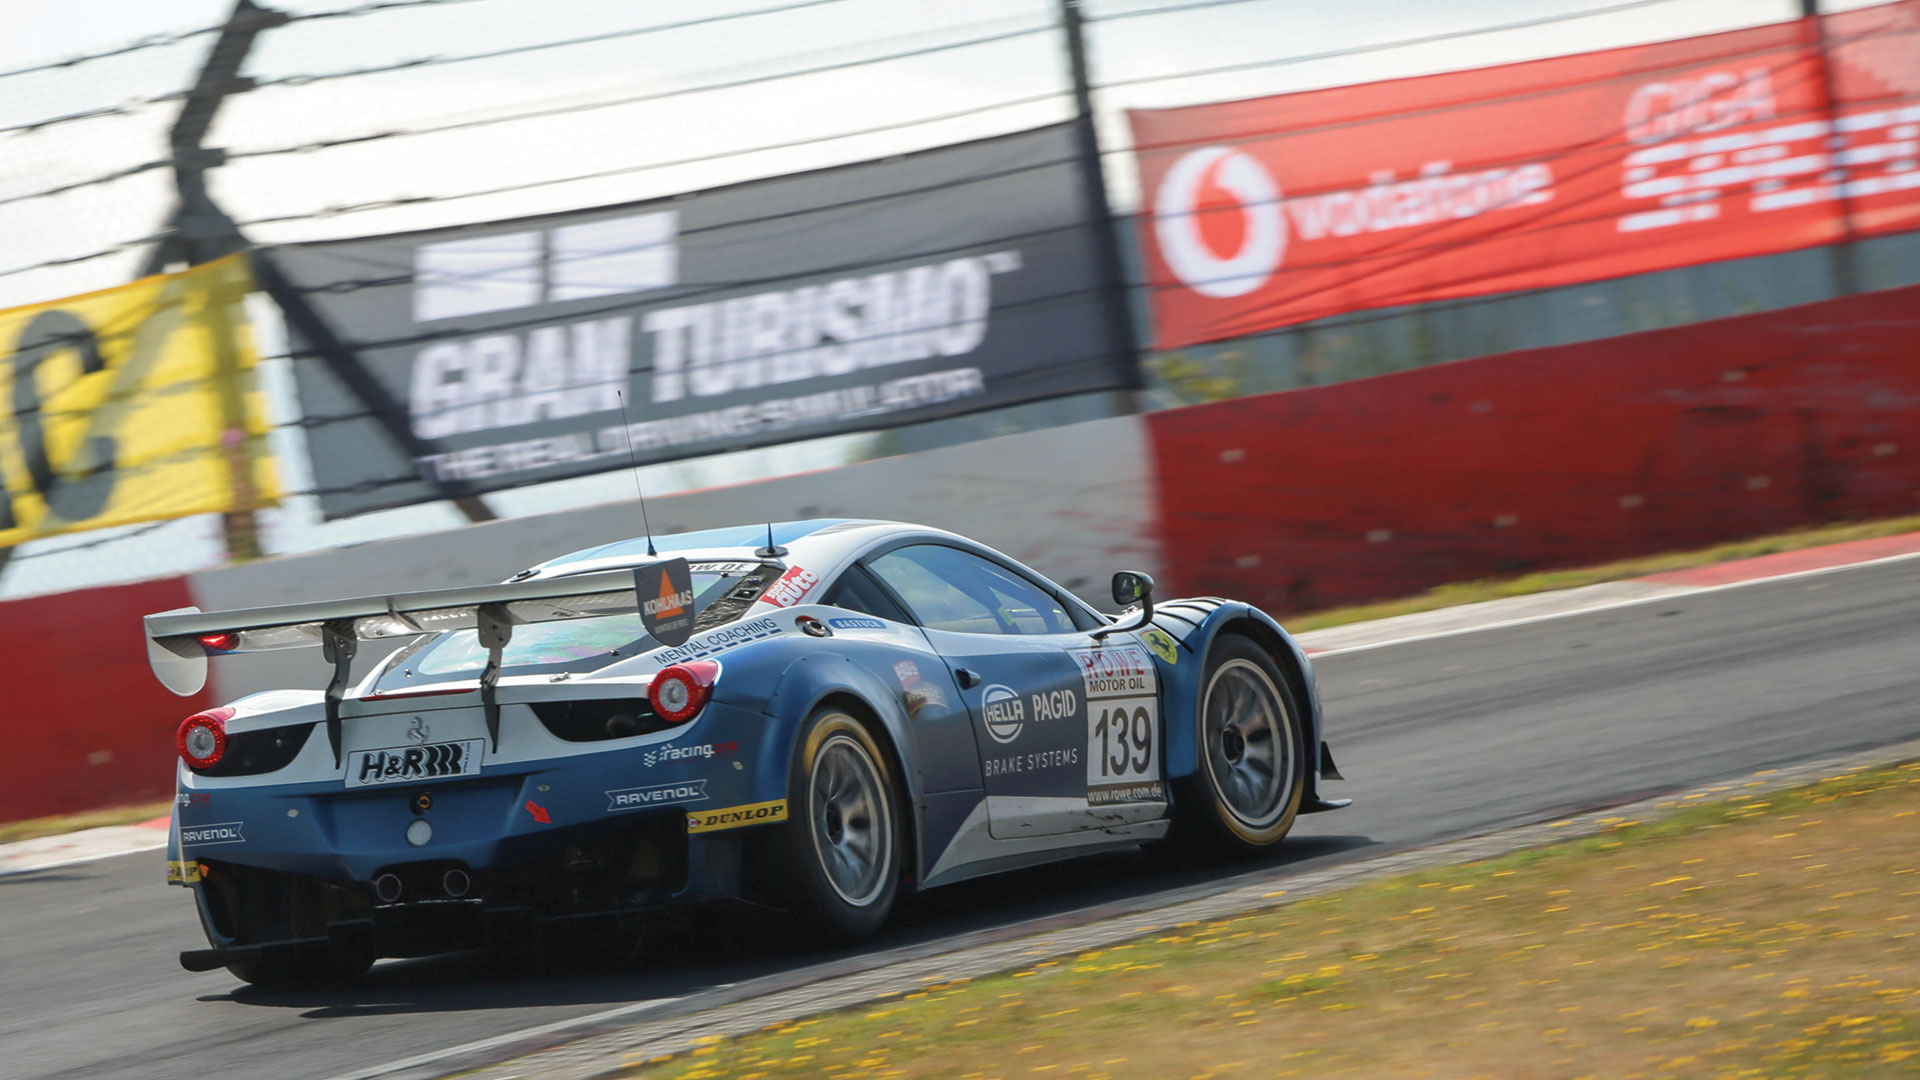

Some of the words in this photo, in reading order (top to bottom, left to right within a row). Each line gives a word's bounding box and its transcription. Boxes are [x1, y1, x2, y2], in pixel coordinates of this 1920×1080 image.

[1286, 160, 1556, 241] vodafone
[409, 316, 633, 441] GRAN
[643, 256, 991, 402] TURISMO
[766, 578, 791, 600] sport
[776, 568, 819, 608] auto
[643, 590, 693, 616] KOHLHAAS
[836, 619, 881, 629] BASTUCK
[653, 641, 709, 665] MENTAL
[706, 617, 778, 646] COACHING
[1080, 650, 1145, 679] ROWE
[1089, 680, 1126, 693] MOTOR
[1128, 677, 1145, 690] OIL
[986, 699, 1025, 722] HELLA
[1032, 689, 1077, 722] PAGID
[1095, 705, 1152, 777] 139
[985, 755, 1023, 777] BRAKE
[1027, 748, 1078, 770] SYSTEMS
[616, 786, 701, 806] RAVENOL
[1087, 783, 1162, 803] www.rowe.com.de
[704, 804, 784, 827] DUNLOP
[183, 827, 238, 842] RAVENOL
